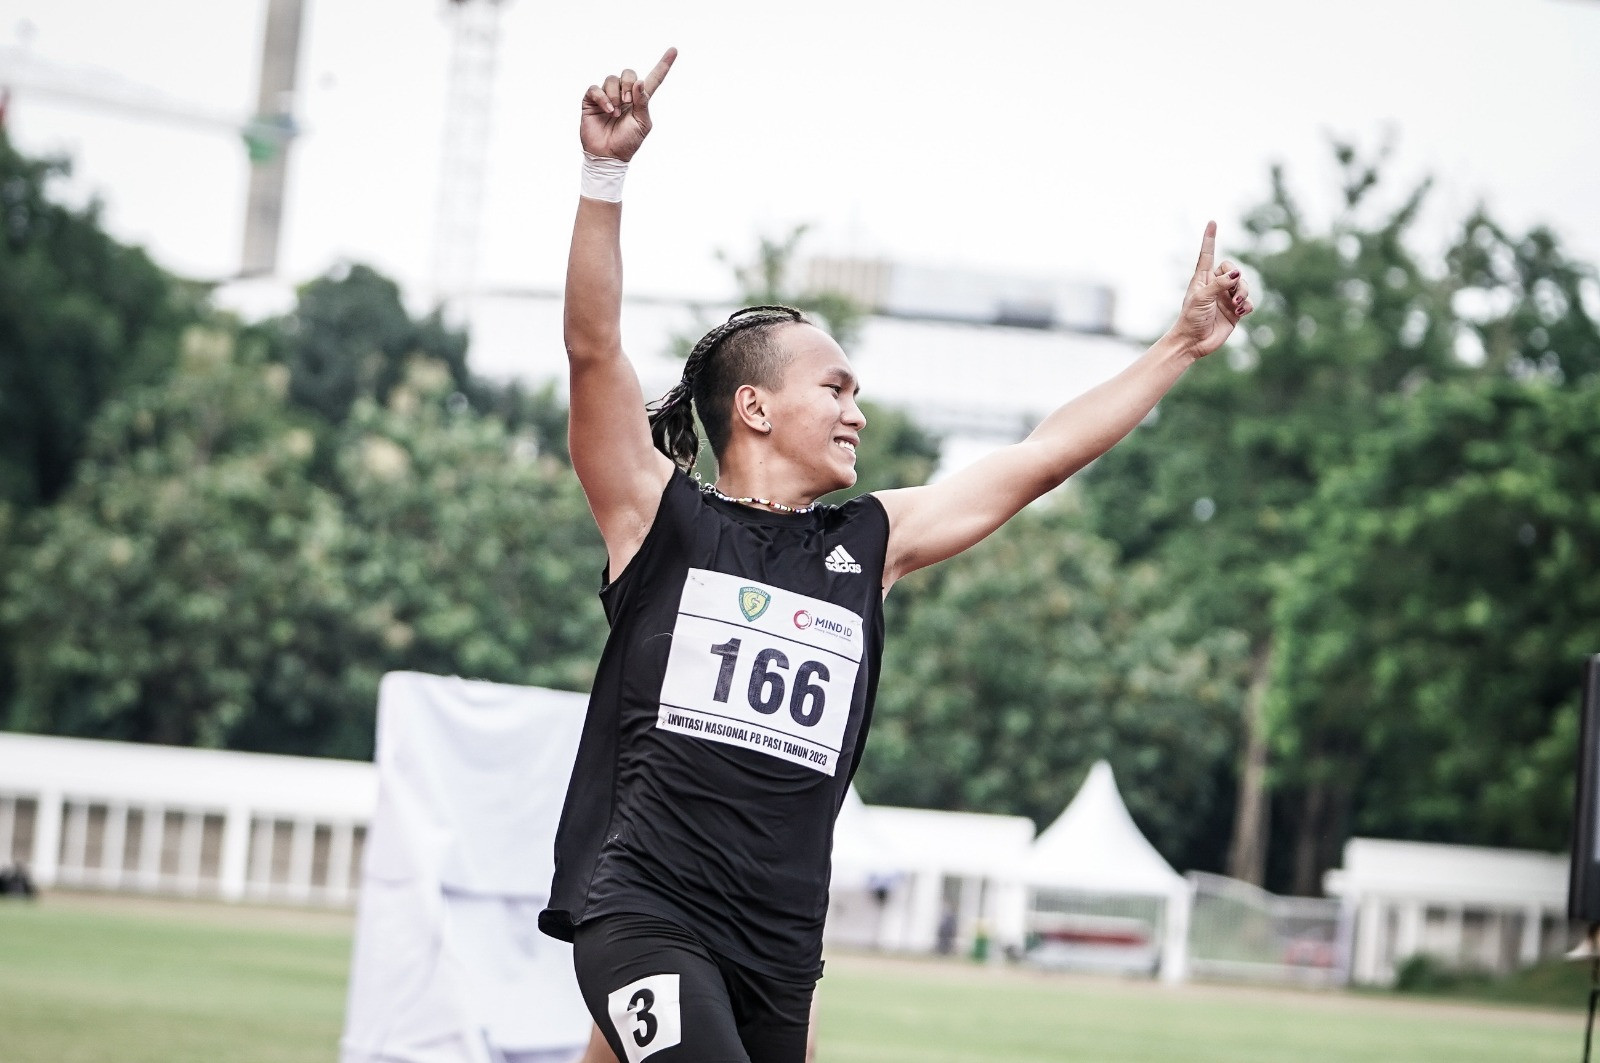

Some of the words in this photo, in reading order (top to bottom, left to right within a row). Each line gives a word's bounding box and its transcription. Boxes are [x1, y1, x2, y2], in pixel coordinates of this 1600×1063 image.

[825, 561, 862, 574] adidas
[815, 617, 843, 633] MIND
[843, 626, 853, 637] ID
[710, 637, 831, 727] 166
[667, 713, 704, 731] INVITASI
[704, 721, 749, 741] NASIONAL
[749, 731, 762, 744] PB
[762, 735, 782, 751] PASI
[783, 741, 809, 759] TAHUN
[808, 749, 828, 766] 2023
[627, 988, 658, 1048] 3
